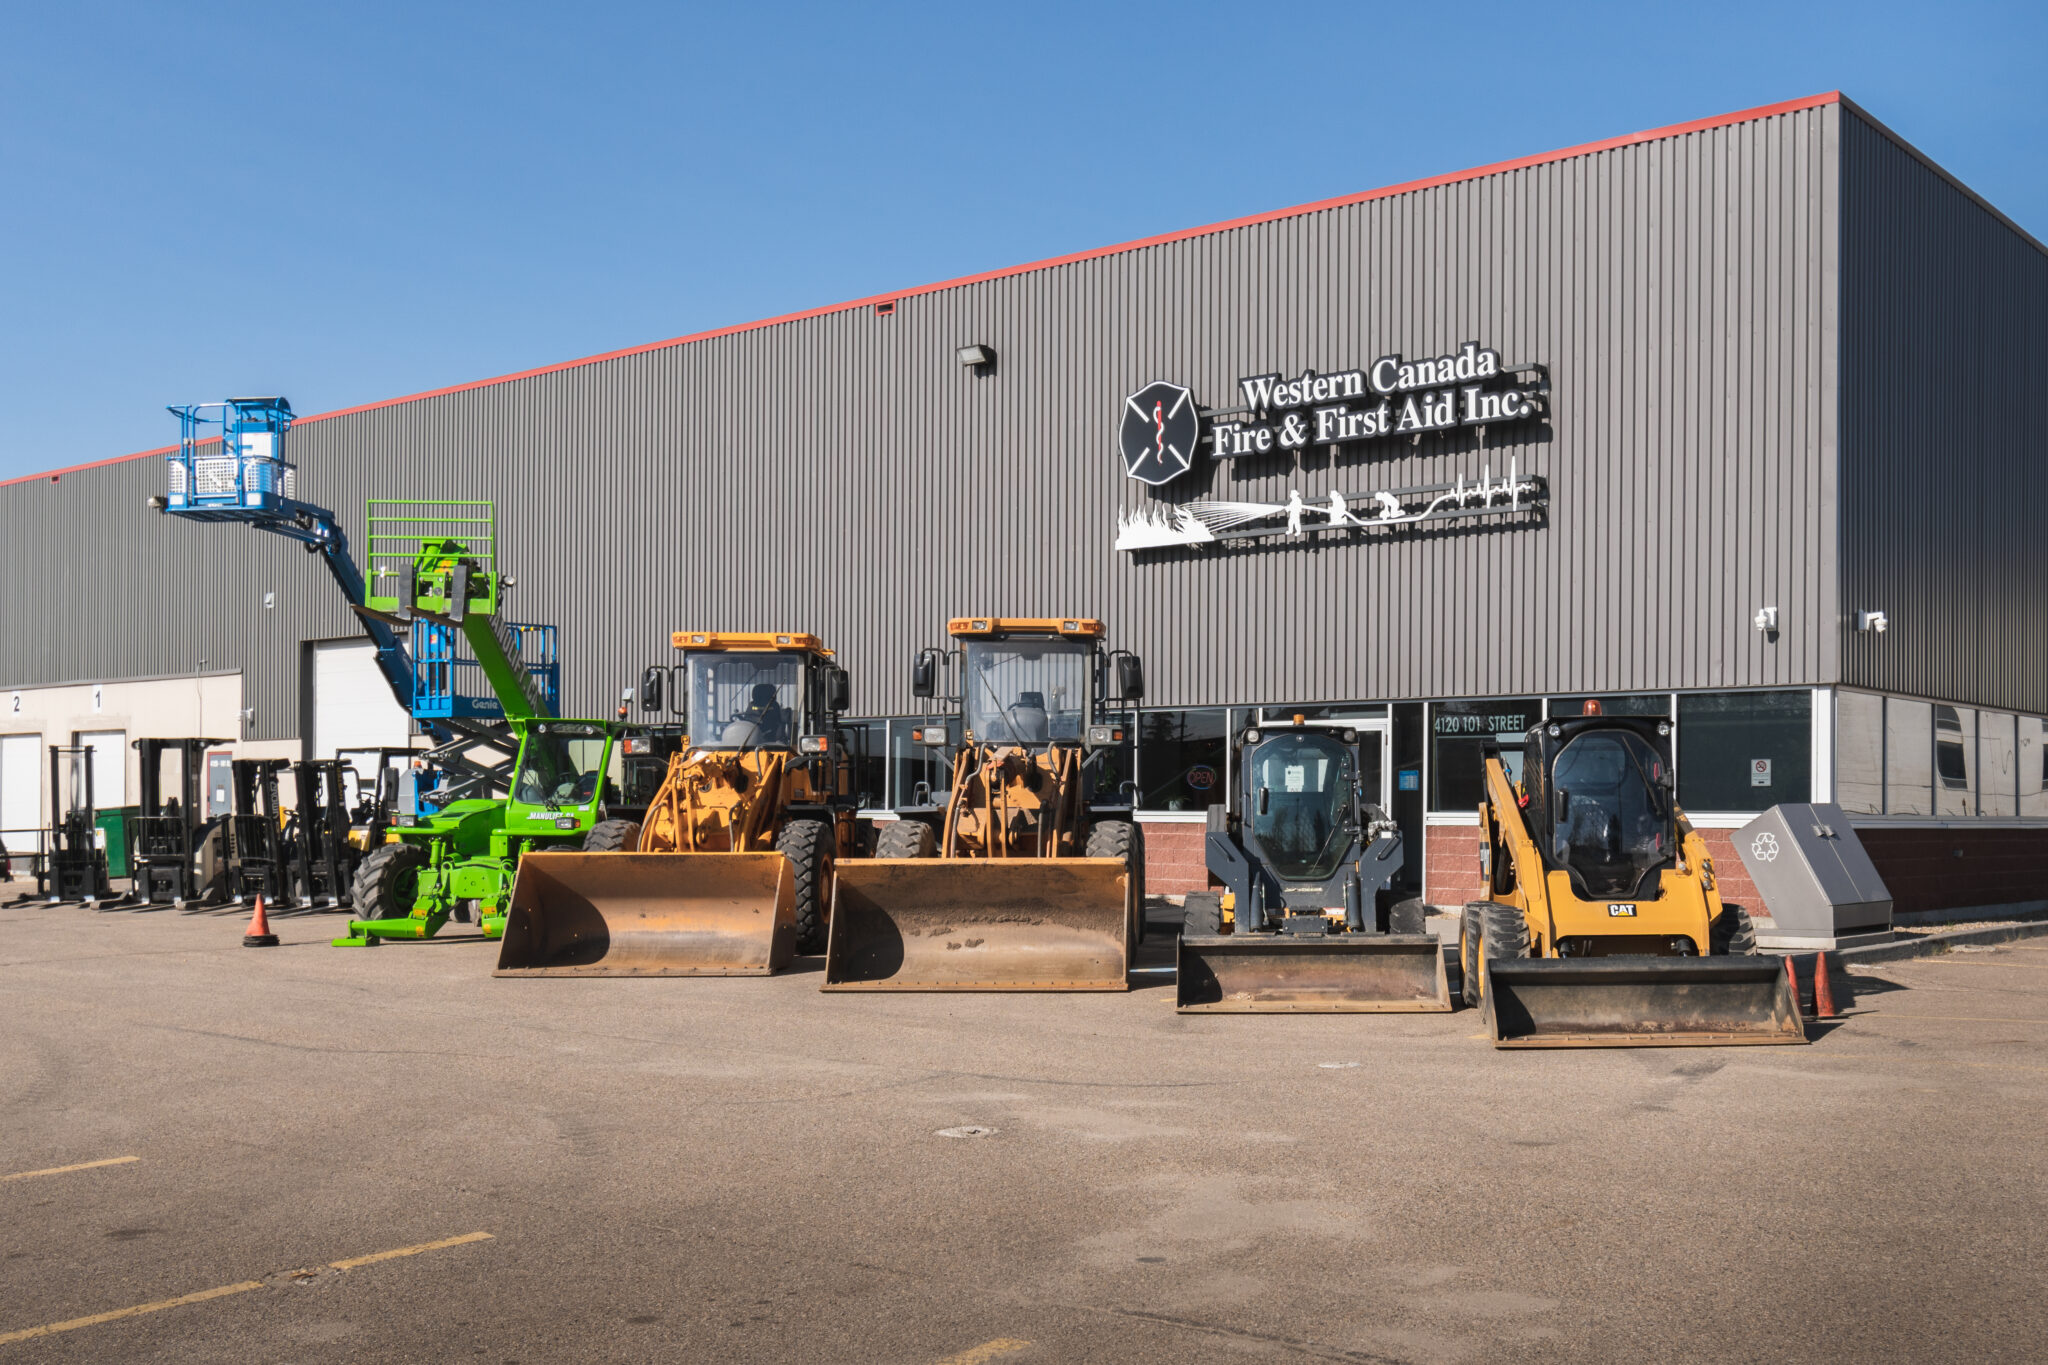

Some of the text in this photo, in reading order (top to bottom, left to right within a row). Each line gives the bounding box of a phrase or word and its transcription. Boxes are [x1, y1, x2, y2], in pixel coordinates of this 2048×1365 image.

[1243, 345, 1497, 411] Western Canada
[1212, 387, 1529, 456] Fire & First Aid Inc.
[13, 695, 20, 712] 2
[95, 690, 101, 708] 1
[471, 699, 499, 709] Genie
[1435, 716, 1460, 733] 4120
[1488, 714, 1526, 731] STREET
[1189, 771, 1215, 784] OPEN
[1610, 904, 1634, 916] CAT
